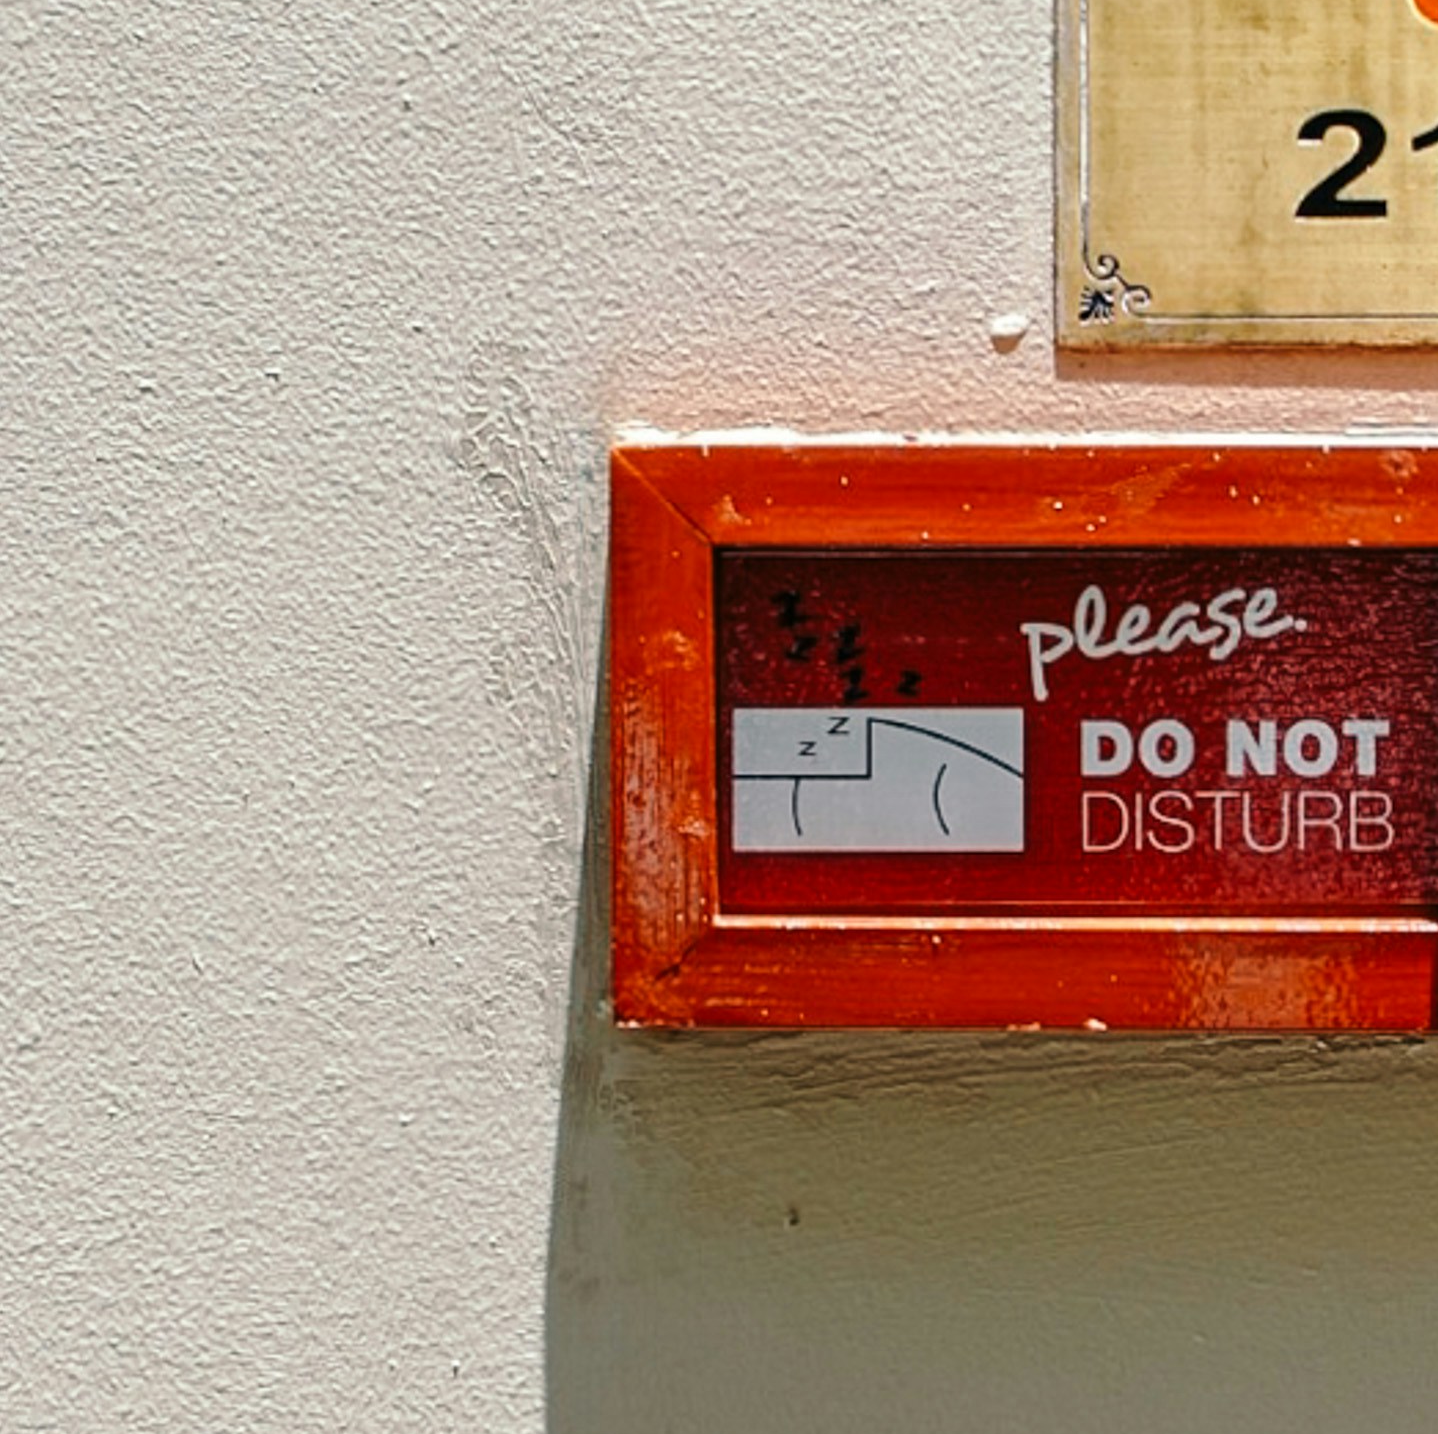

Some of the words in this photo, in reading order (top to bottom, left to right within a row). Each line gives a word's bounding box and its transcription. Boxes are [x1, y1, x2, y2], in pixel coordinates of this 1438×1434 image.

[1080, 719, 1195, 778] DO
[1226, 719, 1391, 778] NOT
[1080, 790, 1395, 853] DISTURB
